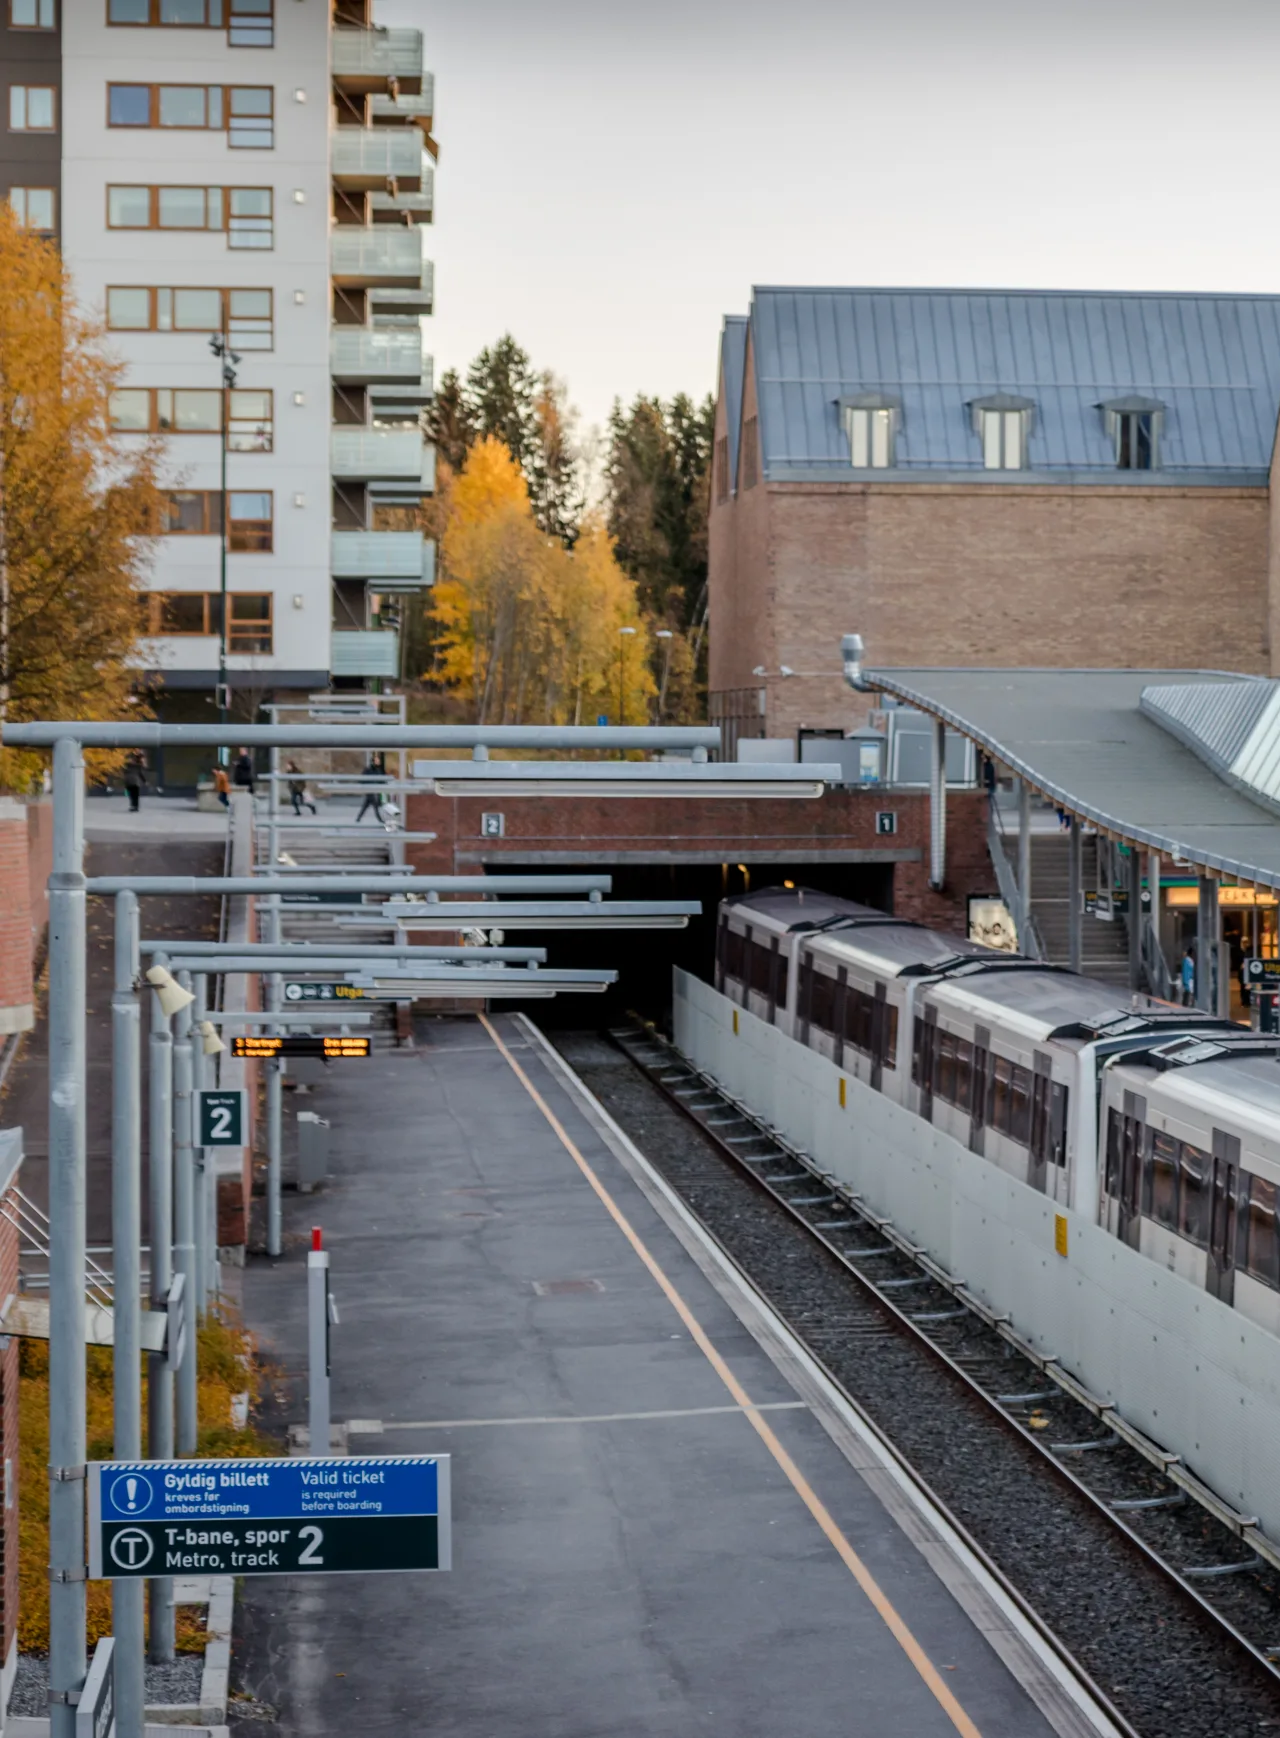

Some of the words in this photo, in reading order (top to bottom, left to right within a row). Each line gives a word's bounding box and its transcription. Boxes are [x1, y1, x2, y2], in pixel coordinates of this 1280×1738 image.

[488, 819, 498, 833] 2
[883, 818, 890, 831] 1
[210, 1107, 232, 1138] 2
[164, 1473, 216, 1491] Gyldig
[220, 1472, 270, 1488] billett
[301, 1471, 338, 1485] Valid
[342, 1470, 385, 1484] ticket
[165, 1493, 202, 1502] kreves
[203, 1491, 220, 1502] før
[301, 1490, 311, 1500] is
[313, 1489, 357, 1501] required
[165, 1503, 250, 1515] ombordstigning
[301, 1501, 334, 1511] before
[337, 1500, 382, 1512] boarding
[165, 1528, 240, 1547] T-bane,
[244, 1528, 291, 1547] spor
[298, 1525, 324, 1566] 2
[165, 1551, 226, 1569] Metro,
[230, 1549, 280, 1567] track
